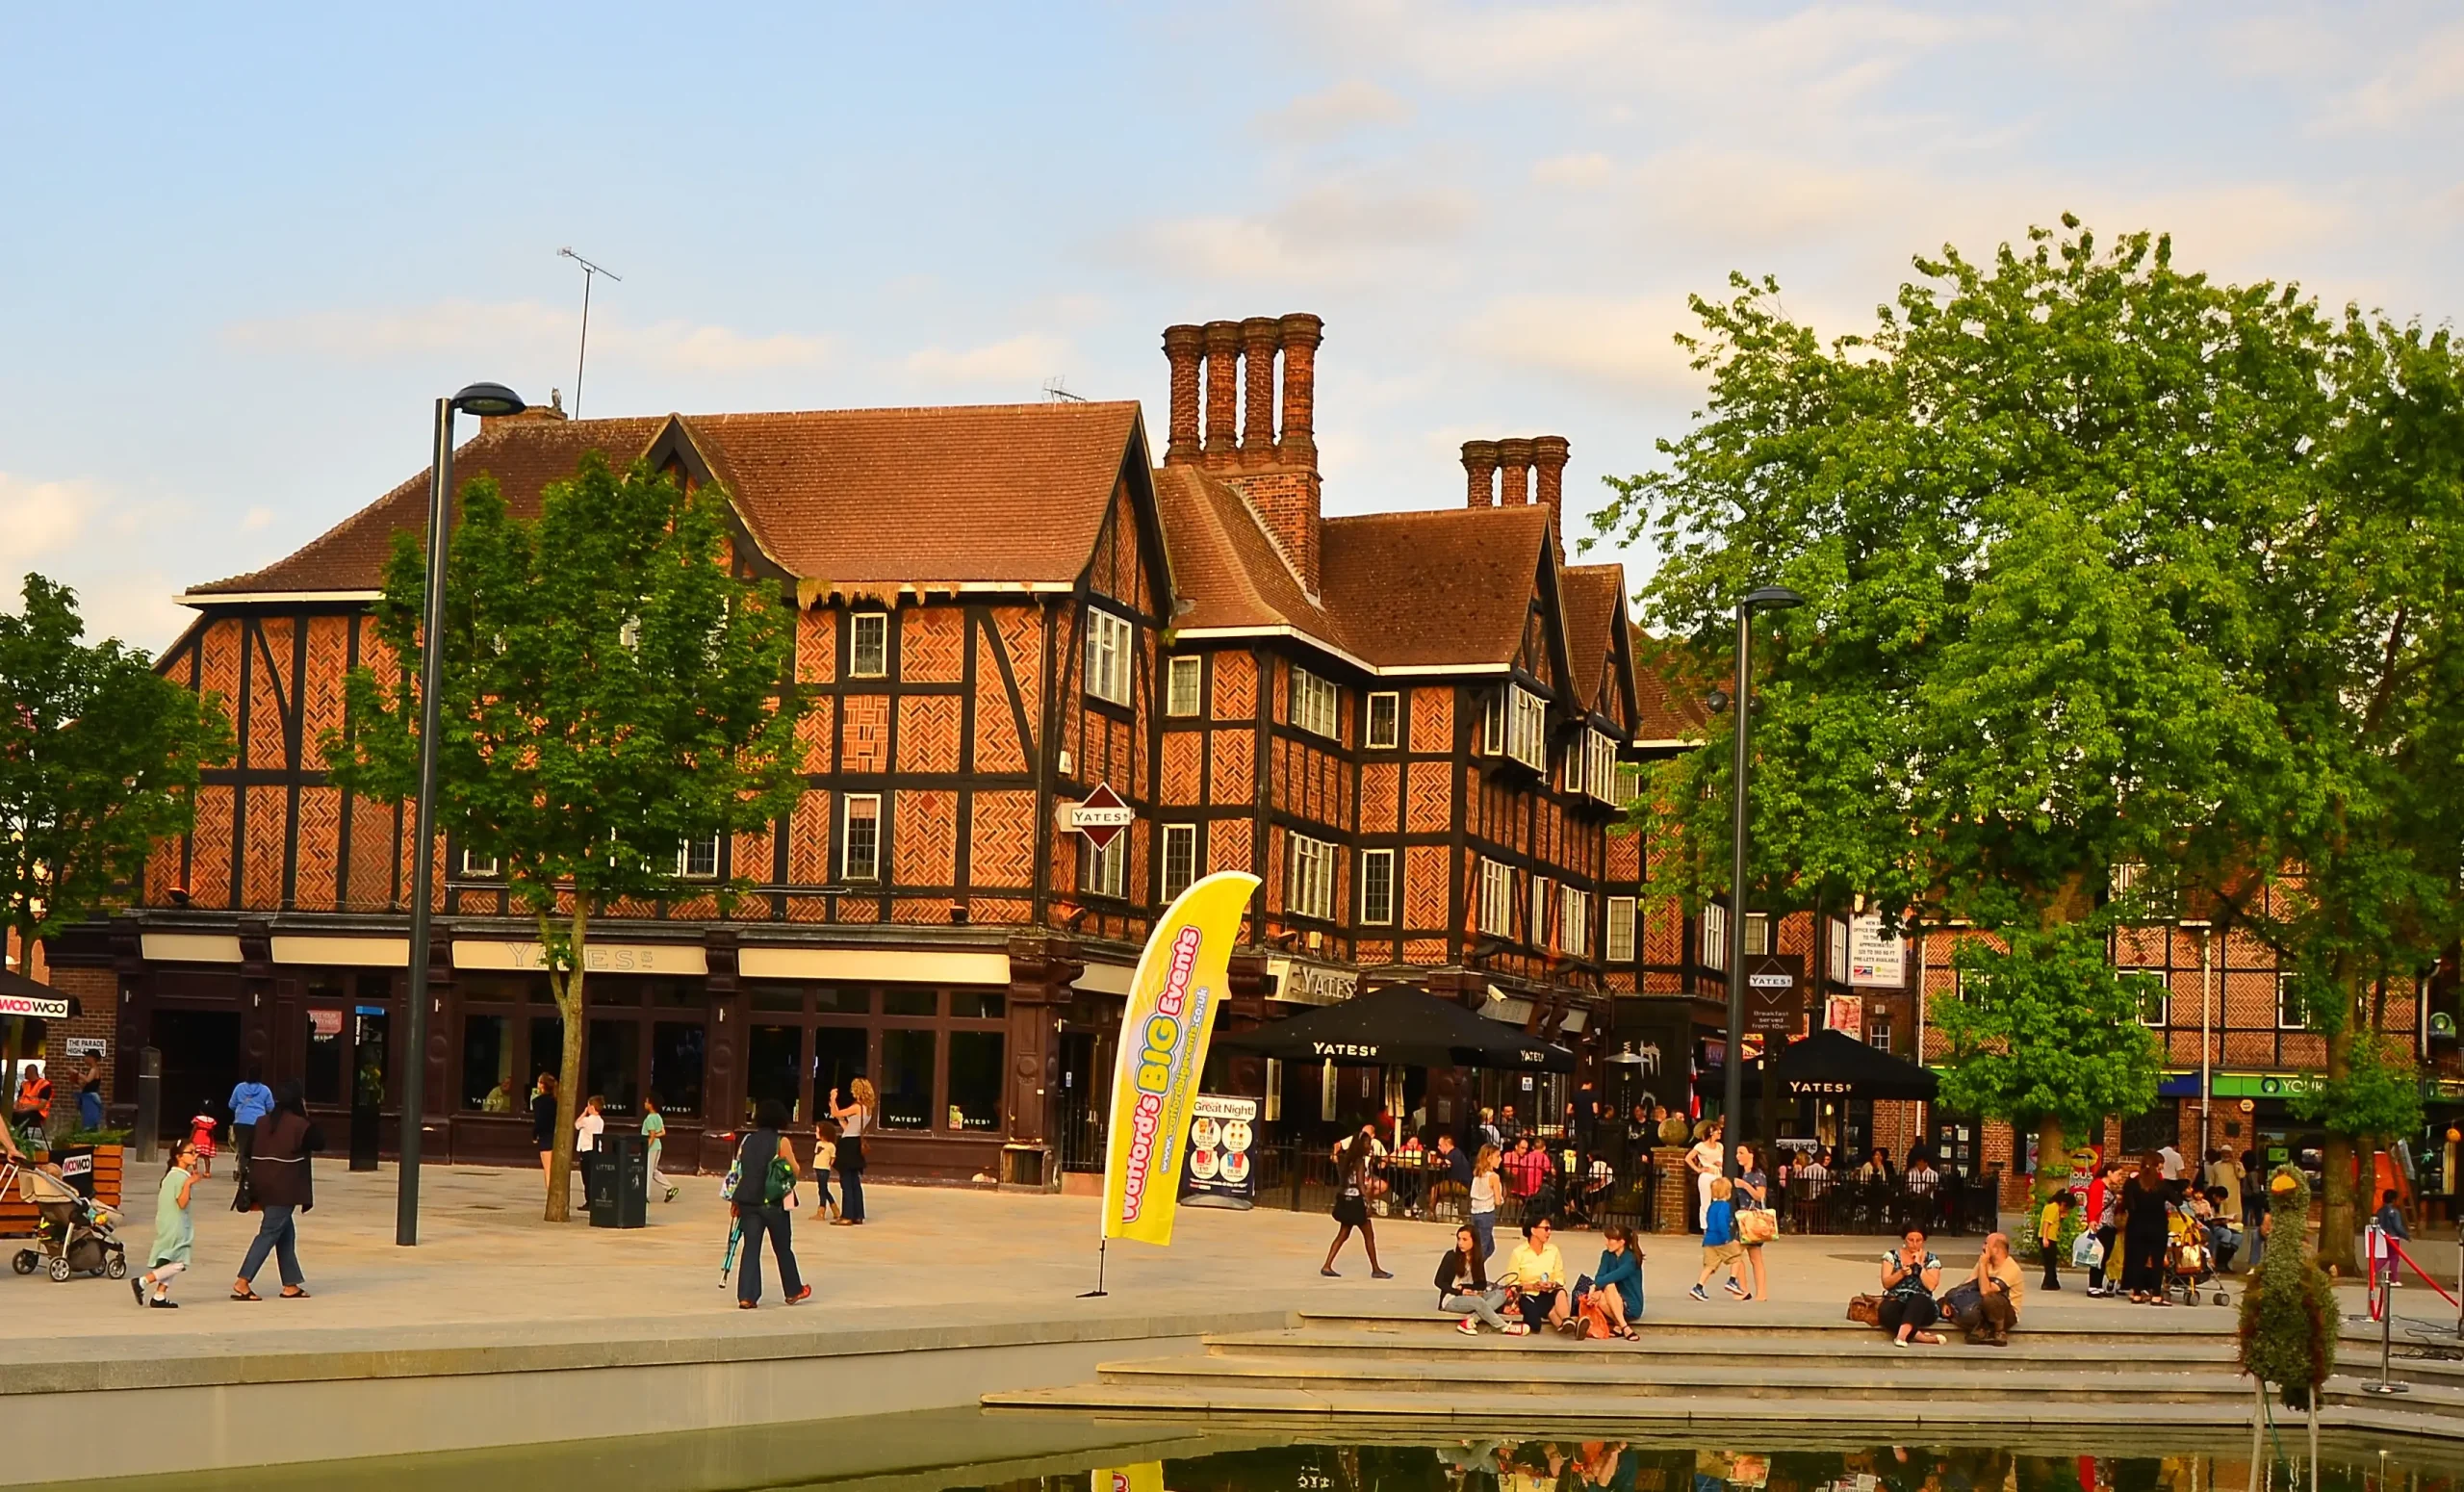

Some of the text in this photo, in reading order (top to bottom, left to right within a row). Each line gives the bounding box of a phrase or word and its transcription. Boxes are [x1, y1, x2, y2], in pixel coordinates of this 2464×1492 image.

[81, 1040, 105, 1048] PARADE
[1120, 926, 1200, 1224] Watford's BIG Events
[1160, 987, 1209, 1173] www.watfordbigevents.co.uk
[1194, 1101, 1221, 1114] Great
[1223, 1103, 1254, 1117] Night!
[596, 1163, 616, 1171] LITTER
